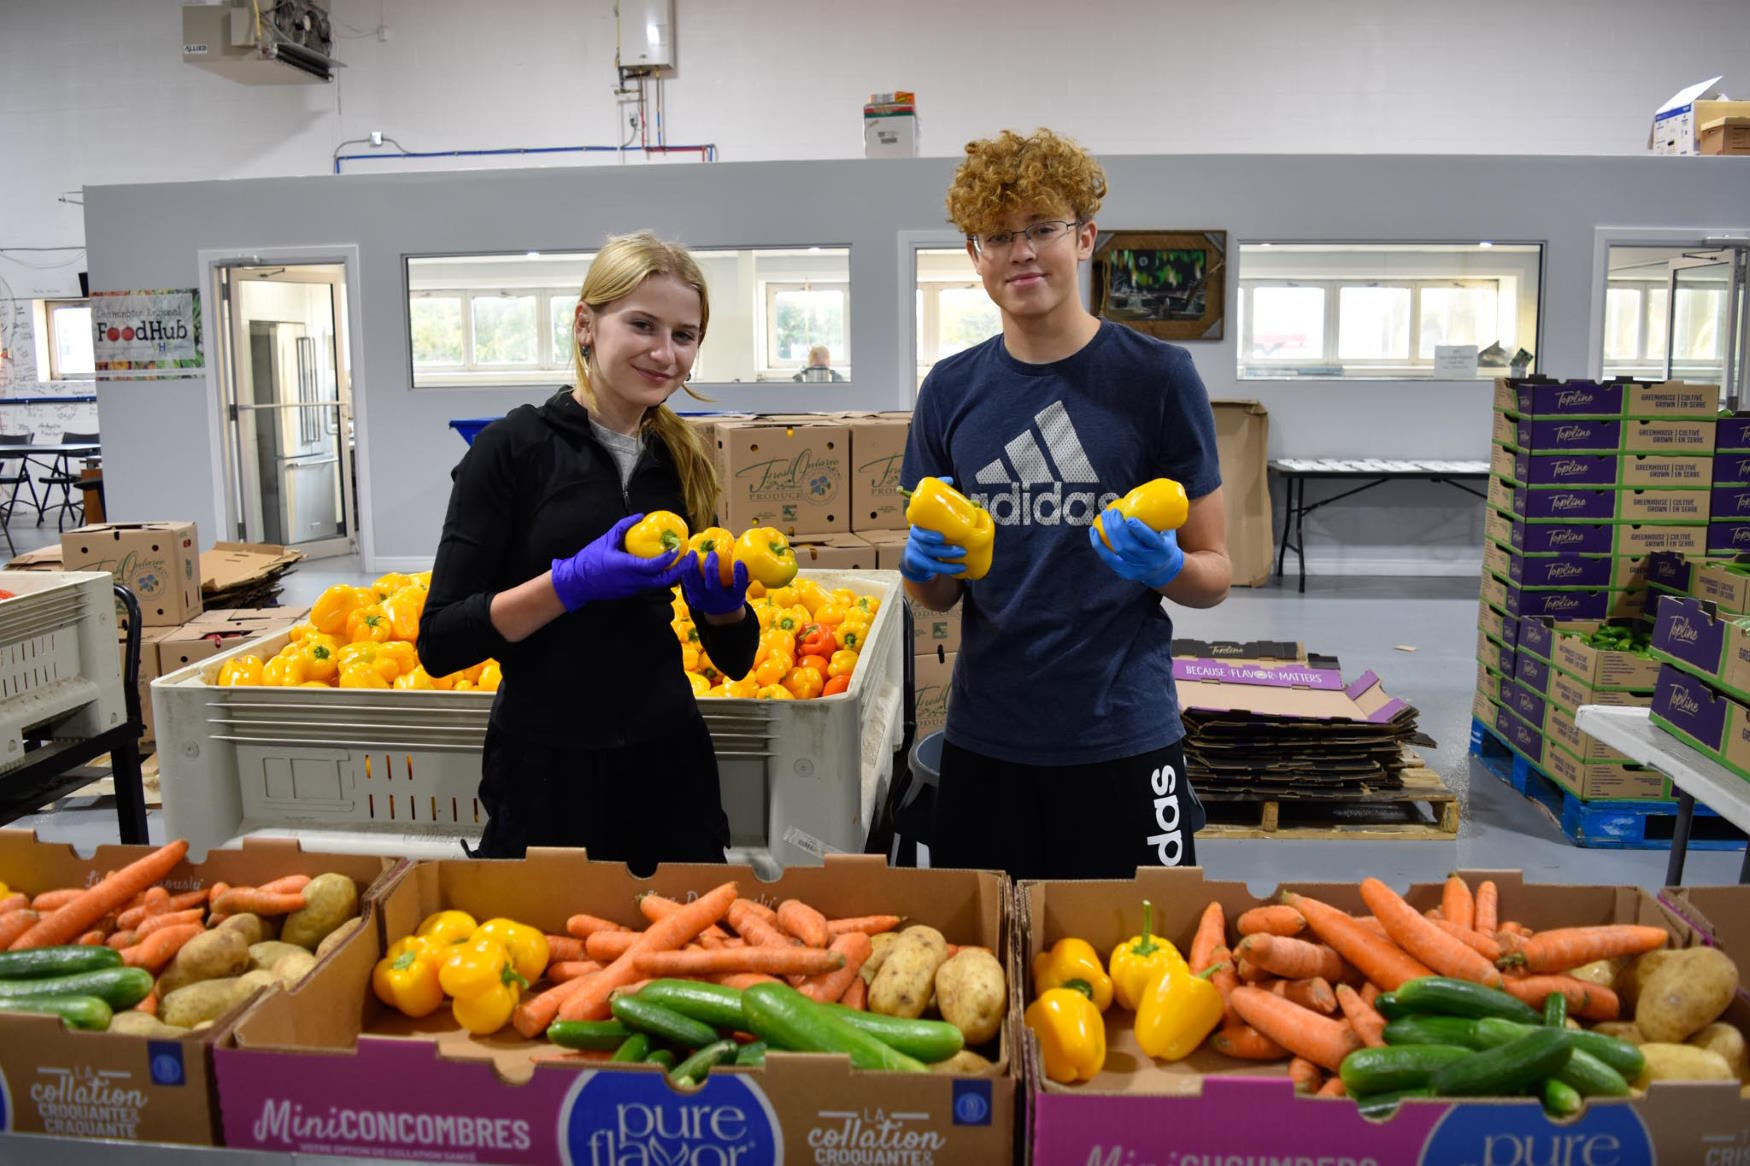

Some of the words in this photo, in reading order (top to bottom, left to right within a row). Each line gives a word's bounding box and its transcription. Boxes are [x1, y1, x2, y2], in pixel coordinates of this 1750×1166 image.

[1554, 390, 1594, 408] Topline
[1553, 425, 1591, 444] Topline
[1550, 460, 1588, 478] Topline
[1548, 494, 1586, 512] Topline
[1546, 529, 1583, 547] Topline
[1545, 562, 1583, 580] Topline
[1542, 595, 1579, 612] Topline
[1668, 615, 1699, 645] Topline
[1185, 665, 1225, 677] BECAUSE
[1279, 671, 1322, 683] MATTERS
[1668, 684, 1699, 716] Topline
[74, 1066, 92, 1078] LA
[30, 1073, 149, 1108] collation
[617, 1102, 748, 1144] pure
[863, 1108, 885, 1122] LA
[45, 1118, 138, 1139] CRAQUANTE
[808, 1118, 947, 1151] collation
[1483, 1134, 1621, 1166] pure
